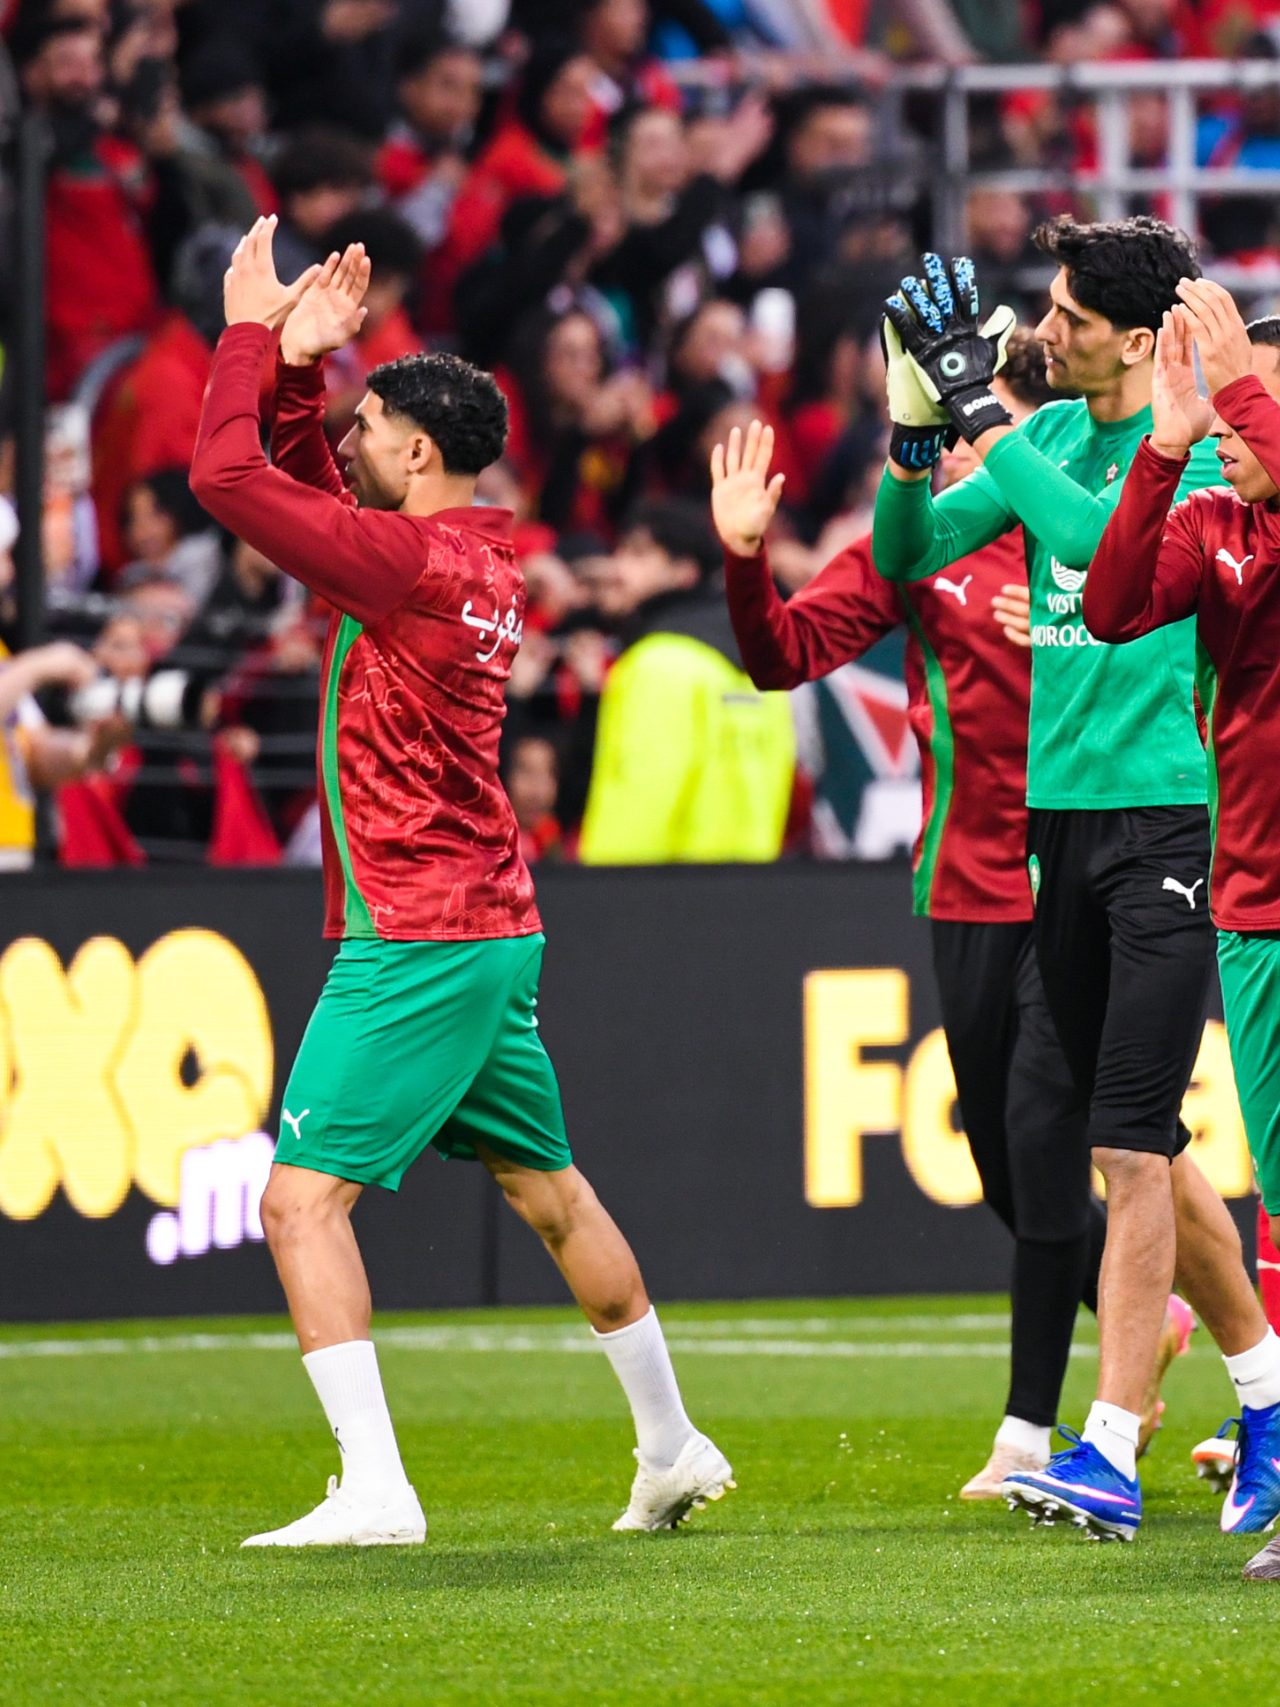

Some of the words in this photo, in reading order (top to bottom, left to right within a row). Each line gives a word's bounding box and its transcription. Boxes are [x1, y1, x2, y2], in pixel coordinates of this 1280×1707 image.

[962, 395, 998, 417] BONO
[1032, 624, 1110, 647] MOROC
[0, 927, 274, 1220] xe
